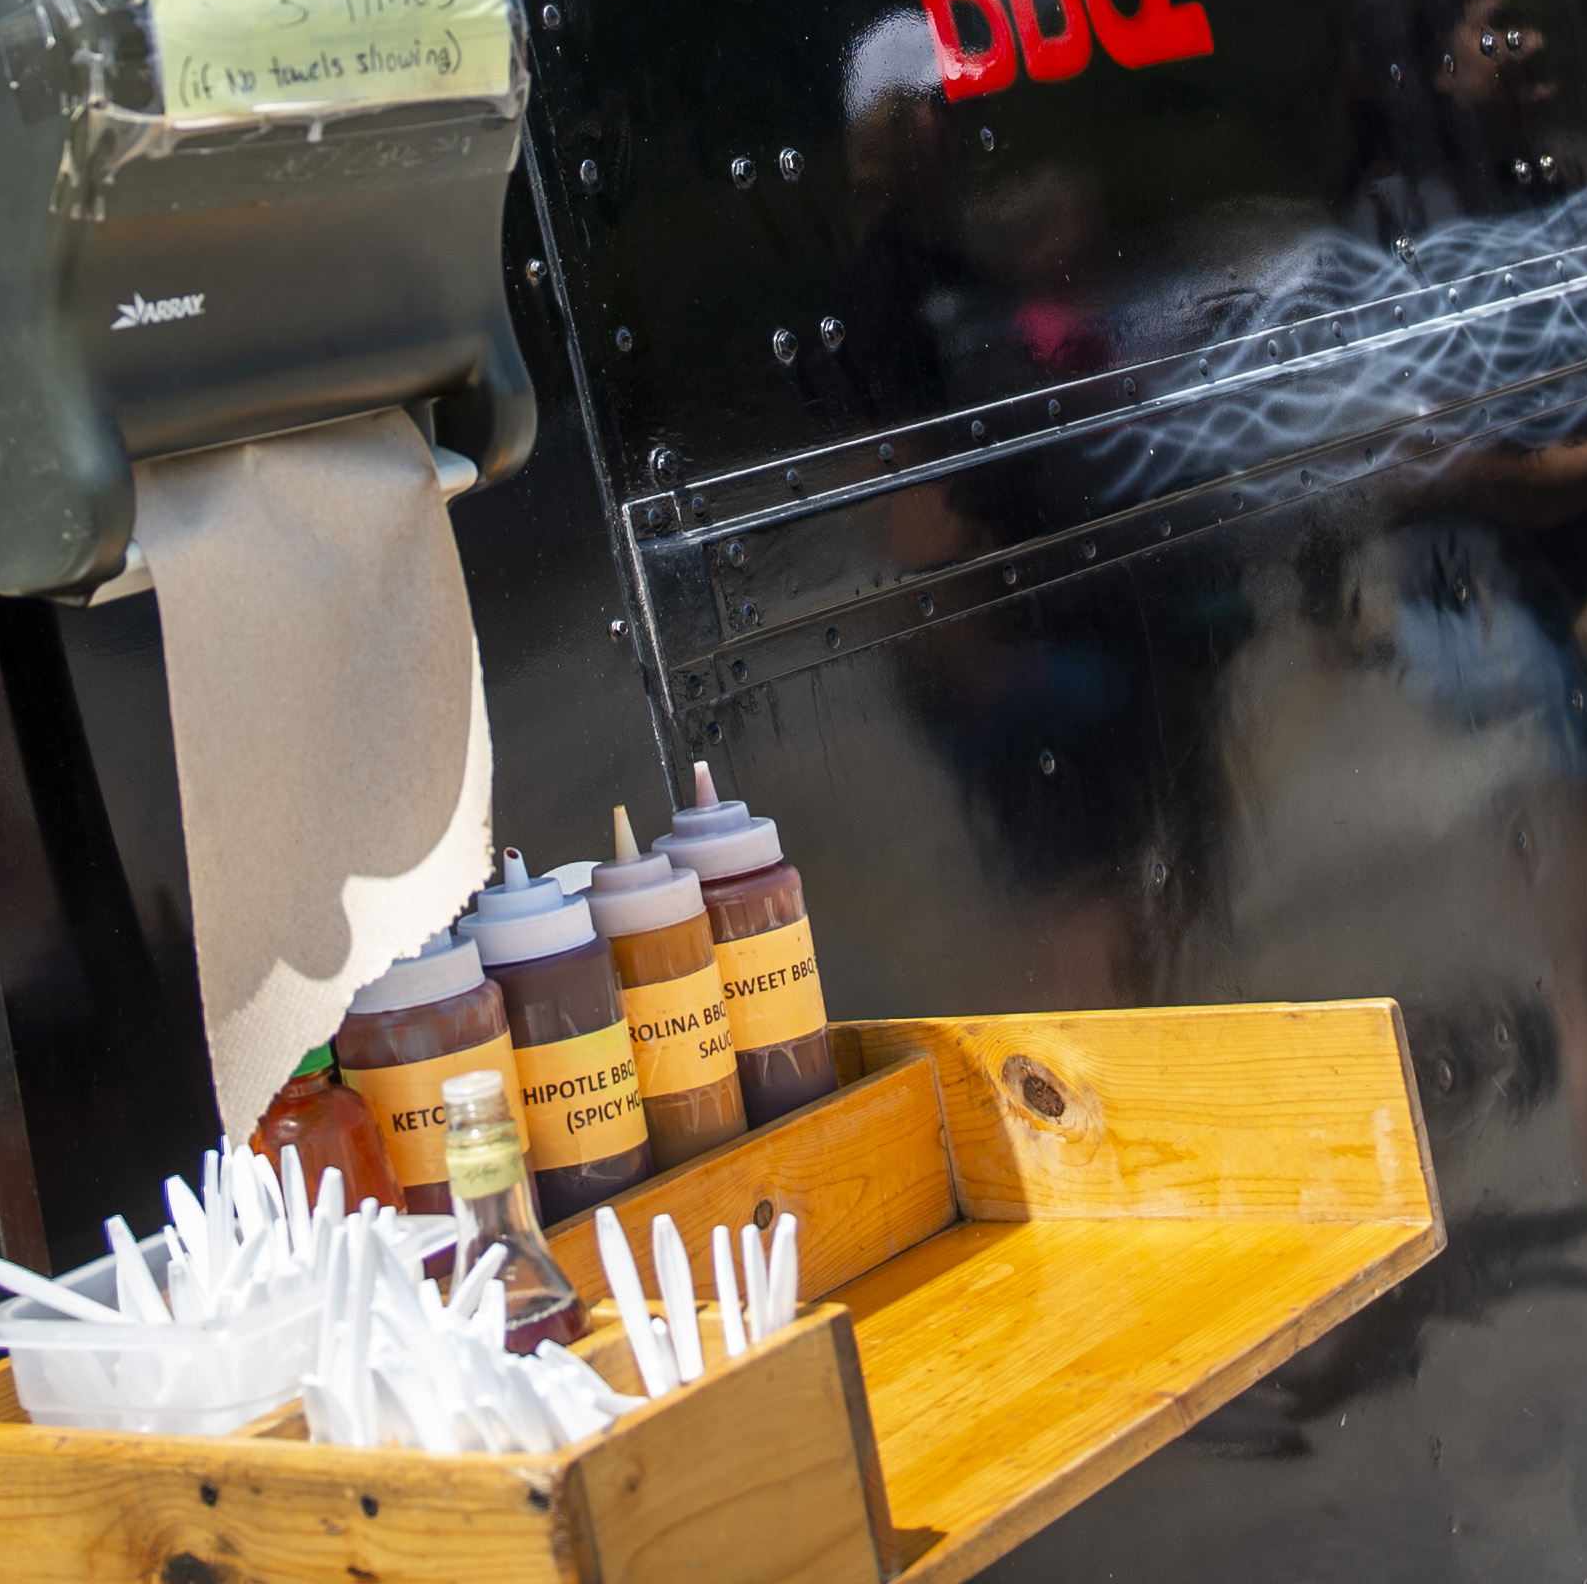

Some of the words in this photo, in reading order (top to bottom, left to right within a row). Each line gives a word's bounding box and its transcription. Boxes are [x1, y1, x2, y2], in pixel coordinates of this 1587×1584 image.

[268, 52, 345, 88] towels
[356, 29, 462, 78] showing)
[140, 293, 206, 325] ARRAY
[723, 968, 787, 1000] SWEET
[791, 956, 816, 982] BBQ
[628, 1013, 701, 1043] ROLINA
[699, 1030, 733, 1059] SAUC
[520, 1071, 608, 1106] HIPOTLE
[392, 1106, 446, 1133] KETC
[567, 1098, 624, 1134] (SPICY
[627, 1091, 643, 1115] HO
